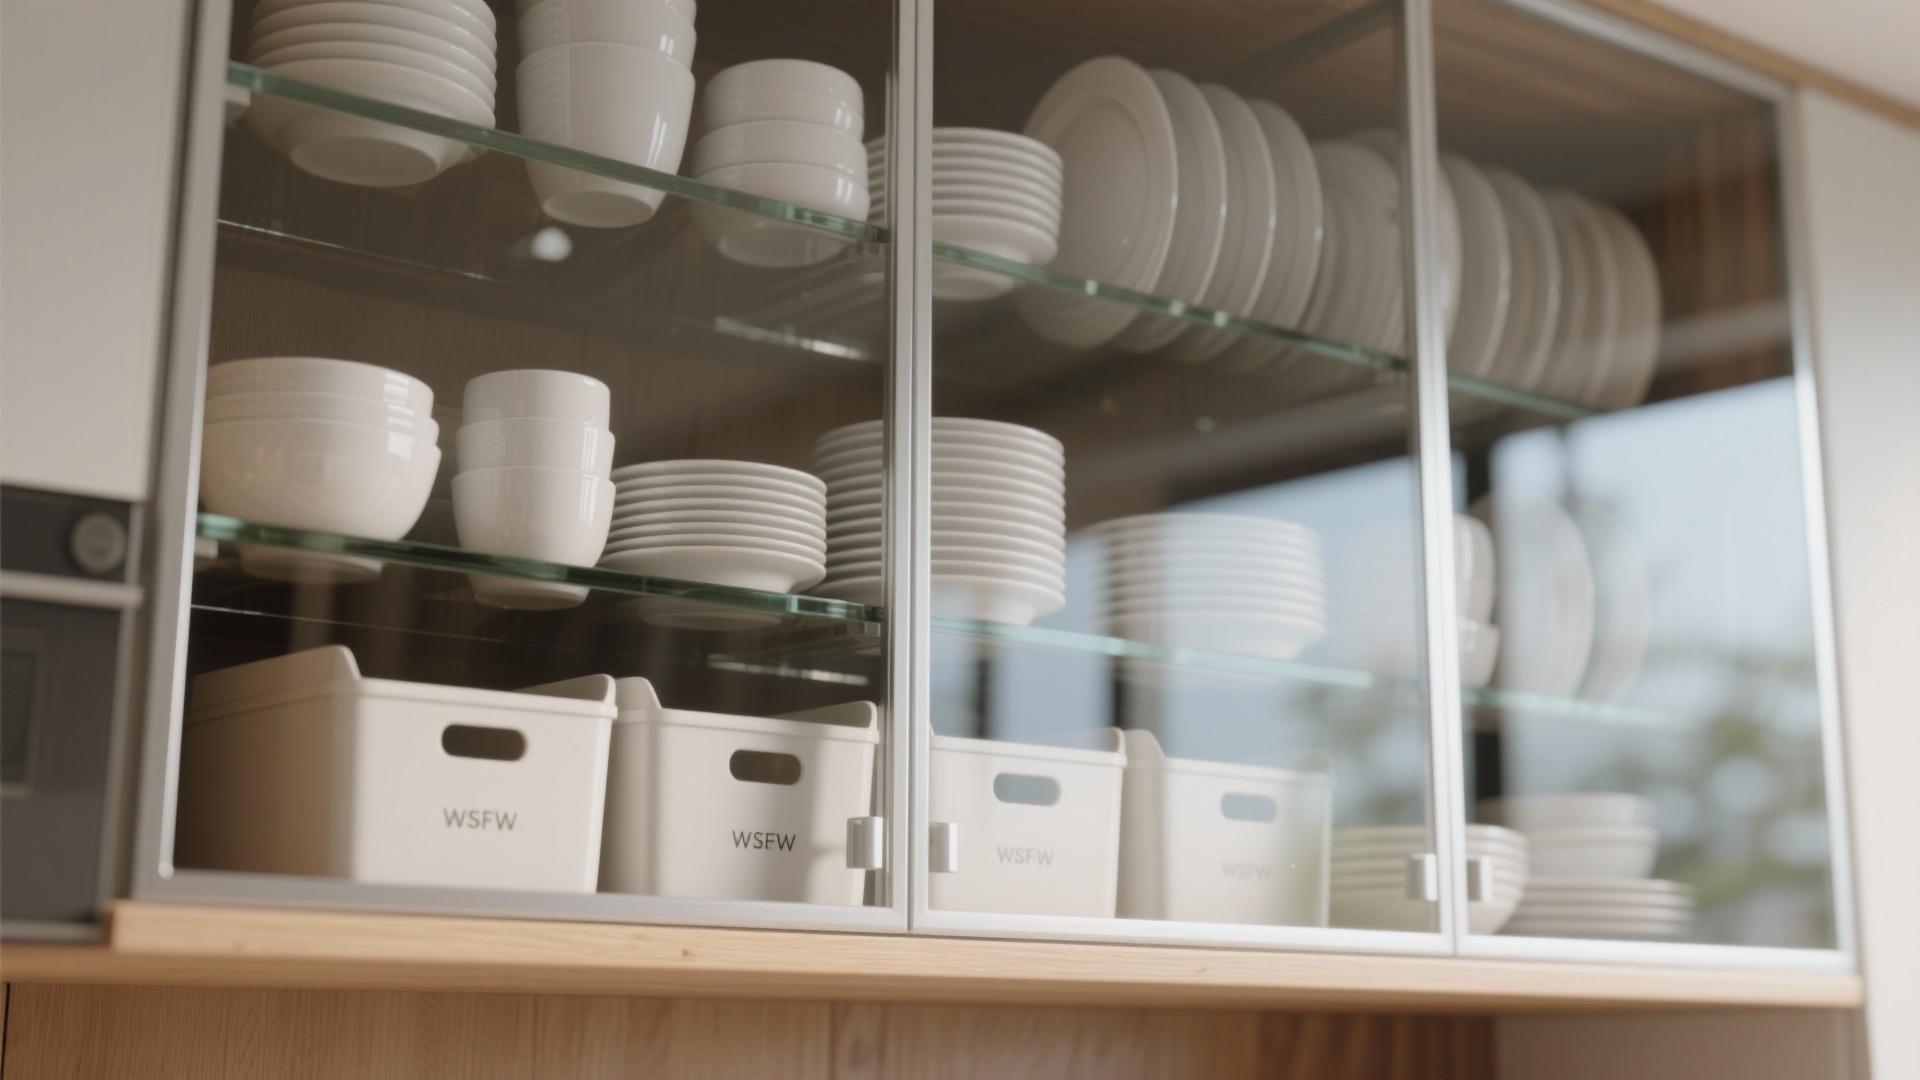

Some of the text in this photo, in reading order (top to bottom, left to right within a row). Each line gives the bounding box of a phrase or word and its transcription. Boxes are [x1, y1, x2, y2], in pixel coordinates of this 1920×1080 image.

[443, 808, 517, 831] WSFW
[732, 830, 796, 852] WSFW
[997, 846, 1054, 866] WSFW
